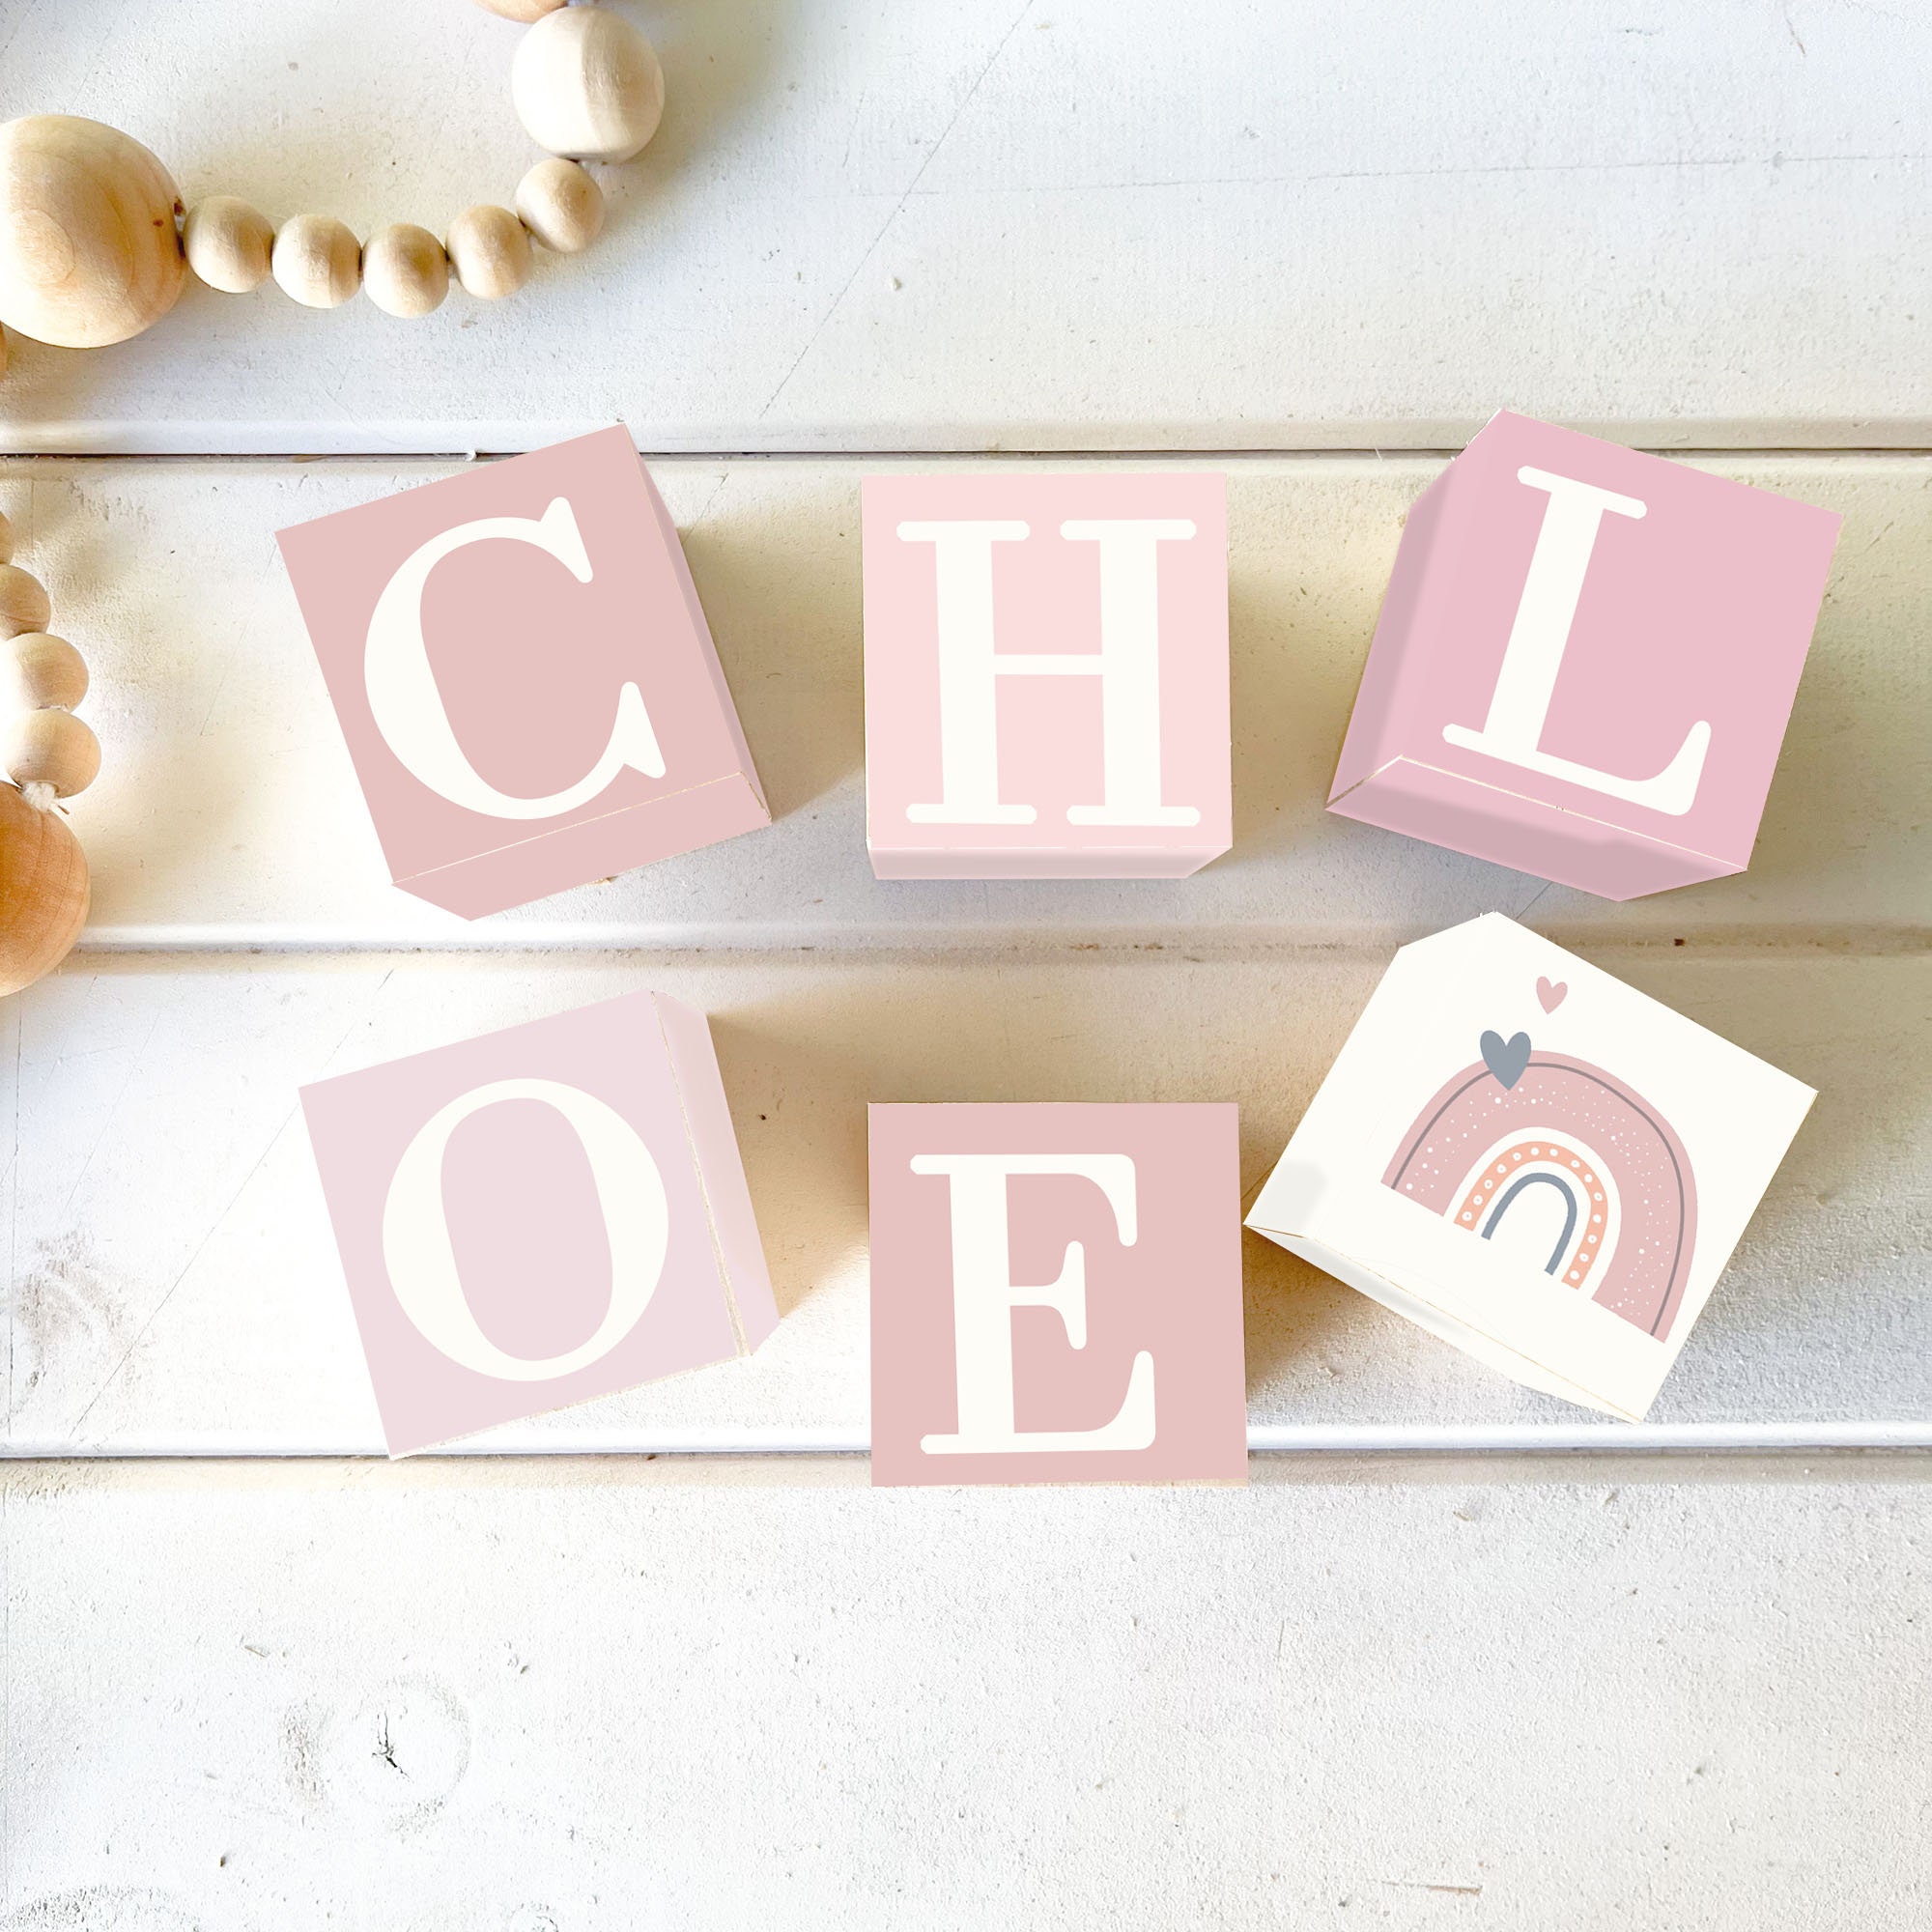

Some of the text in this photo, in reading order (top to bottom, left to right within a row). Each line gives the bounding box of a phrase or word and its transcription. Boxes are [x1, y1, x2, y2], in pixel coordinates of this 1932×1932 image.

[364, 497, 667, 820] C
[896, 519, 1200, 827] H
[1442, 466, 1712, 816] L
[382, 1078, 669, 1382] O
[910, 1153, 1156, 1455] E
